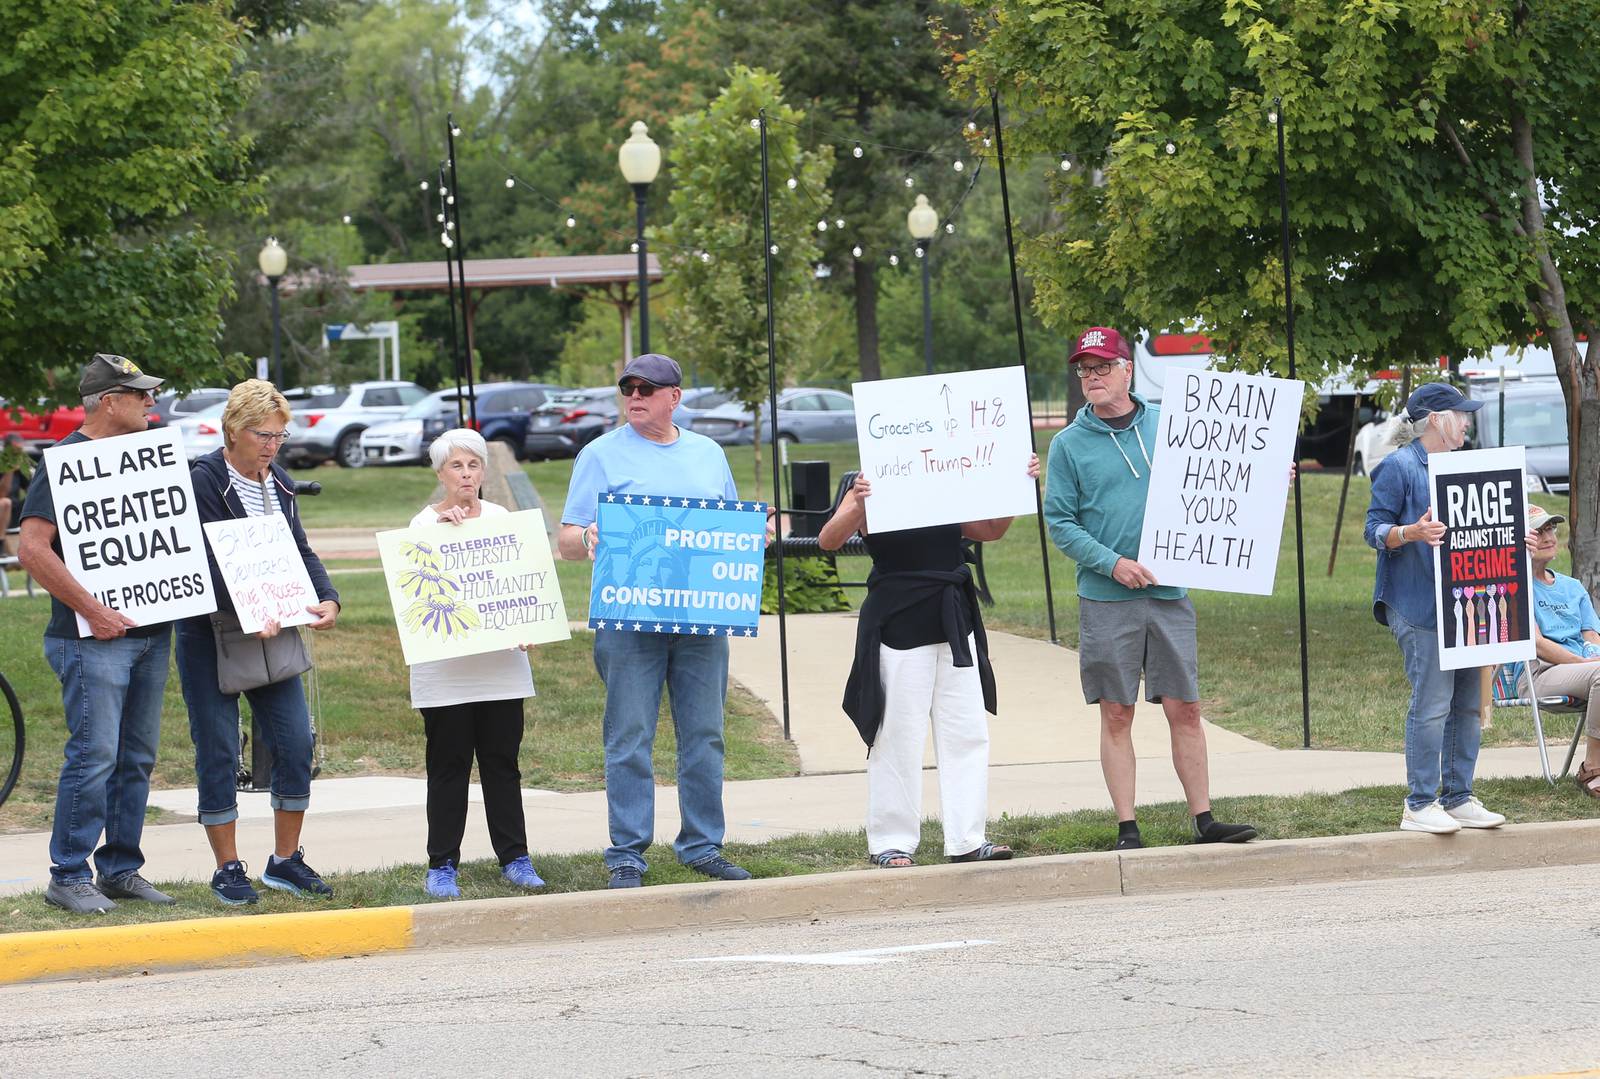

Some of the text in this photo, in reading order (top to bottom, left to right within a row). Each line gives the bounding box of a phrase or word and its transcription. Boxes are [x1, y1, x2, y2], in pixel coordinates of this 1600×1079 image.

[1185, 374, 1276, 421] BRAIN
[868, 413, 933, 439] Groceries
[970, 396, 1006, 429] 14%
[1167, 414, 1270, 454] WORMS
[59, 443, 177, 486] ALL ARE
[875, 442, 995, 479] under Trump!!!
[1183, 456, 1252, 493] HARM
[63, 485, 187, 535] CREATED
[1181, 493, 1238, 526] YOUR
[1446, 480, 1515, 528] RAGE
[78, 526, 192, 571] EQUAL
[439, 534, 518, 554] CELEBRATE
[664, 528, 763, 552] PROTECT
[1153, 529, 1254, 570] HEALTH
[1450, 526, 1516, 550] AGAINST THE
[444, 542, 524, 571] DIVERSITY
[712, 561, 759, 582] OUR
[1450, 547, 1518, 582] REGIME
[93, 572, 205, 611] UE PROCESS
[459, 570, 495, 584] LOVE
[463, 571, 548, 601] HUMANITY
[235, 581, 306, 608] DUE PROCESS
[478, 595, 539, 613] DEMAND
[601, 585, 757, 612] CONSTITUTION
[484, 602, 558, 631] EQUALITY
